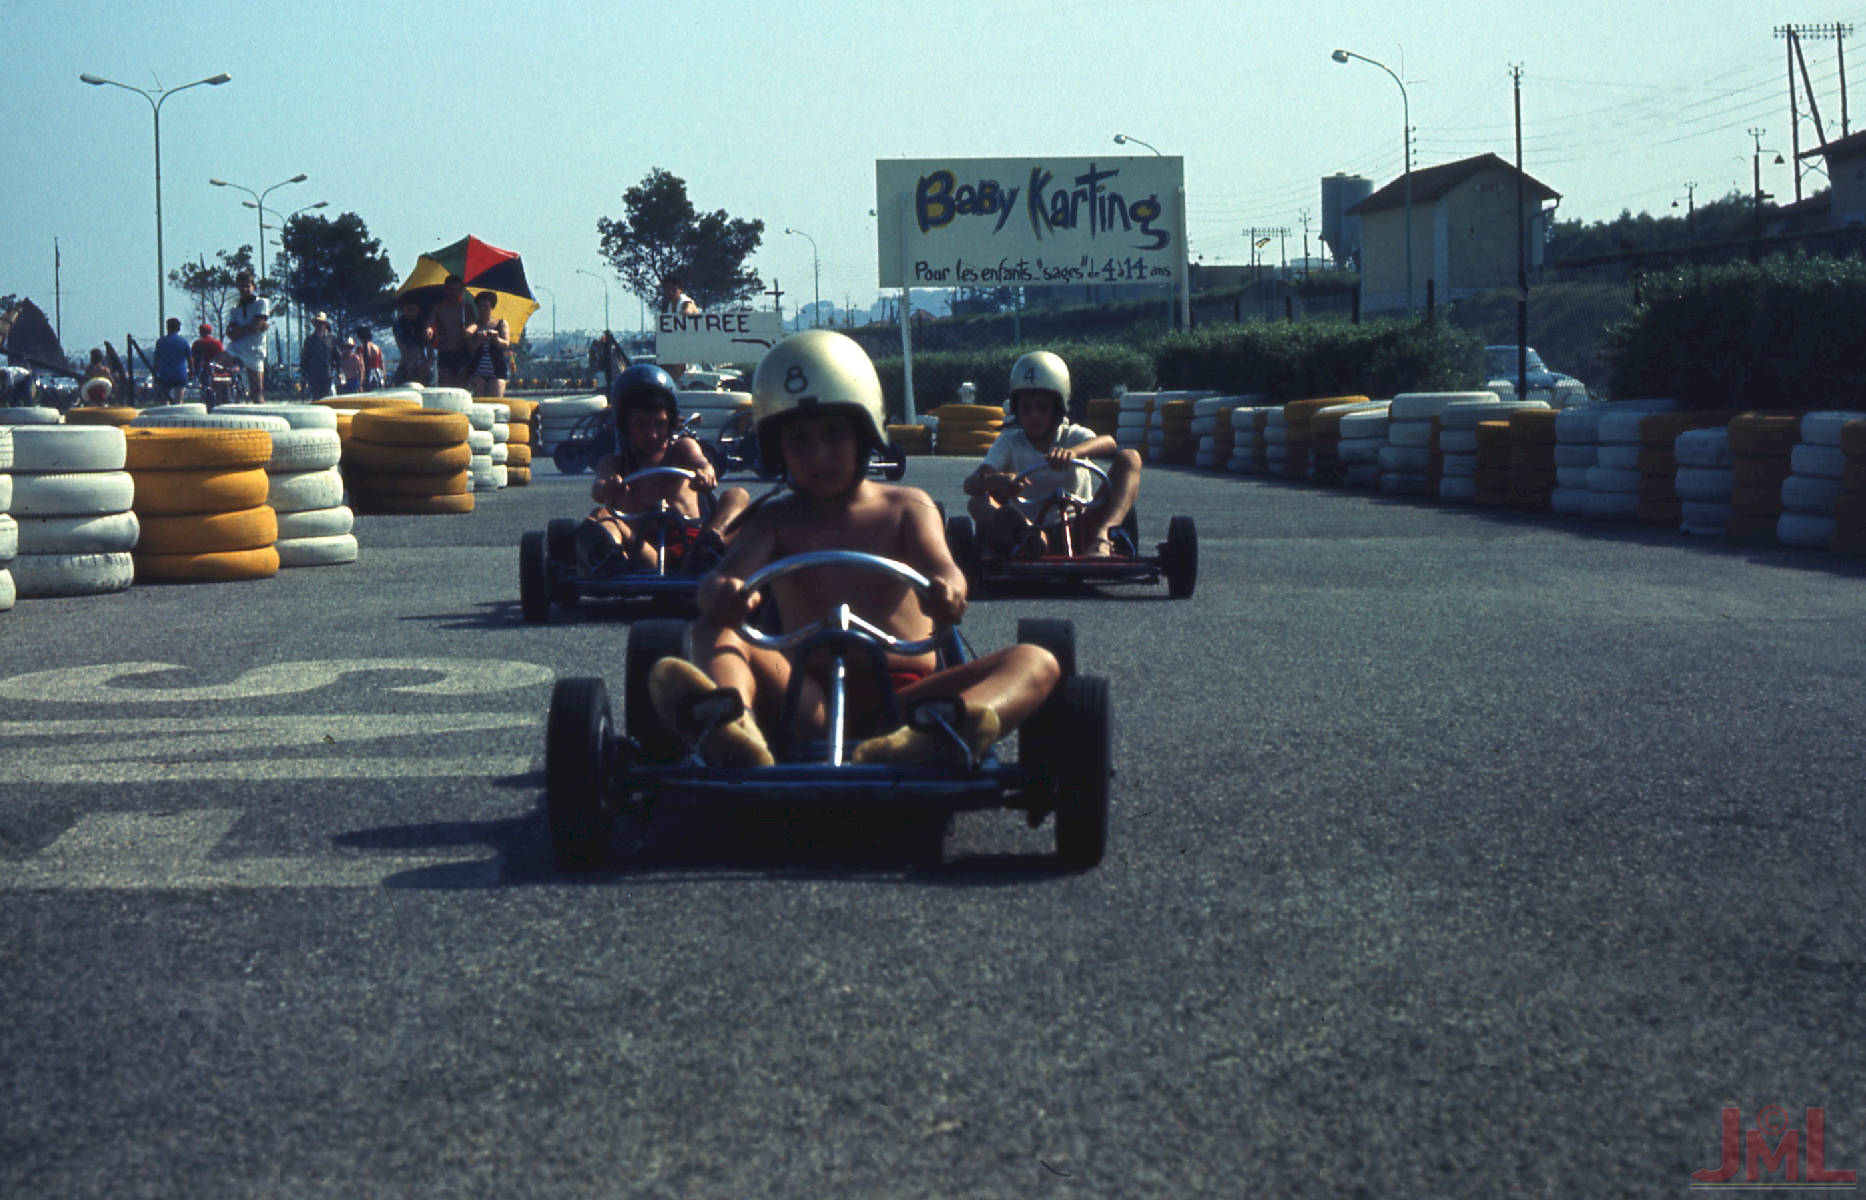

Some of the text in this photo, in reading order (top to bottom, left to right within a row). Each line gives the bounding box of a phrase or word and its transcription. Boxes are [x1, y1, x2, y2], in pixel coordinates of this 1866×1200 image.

[915, 260, 950, 281] Pour
[956, 258, 979, 281] les
[1101, 257, 1118, 282] 4
[1124, 256, 1148, 280] 14
[1150, 265, 1171, 277] ans
[659, 314, 750, 333] ENTREE
[784, 365, 808, 394] 8
[1023, 367, 1036, 385] 4
